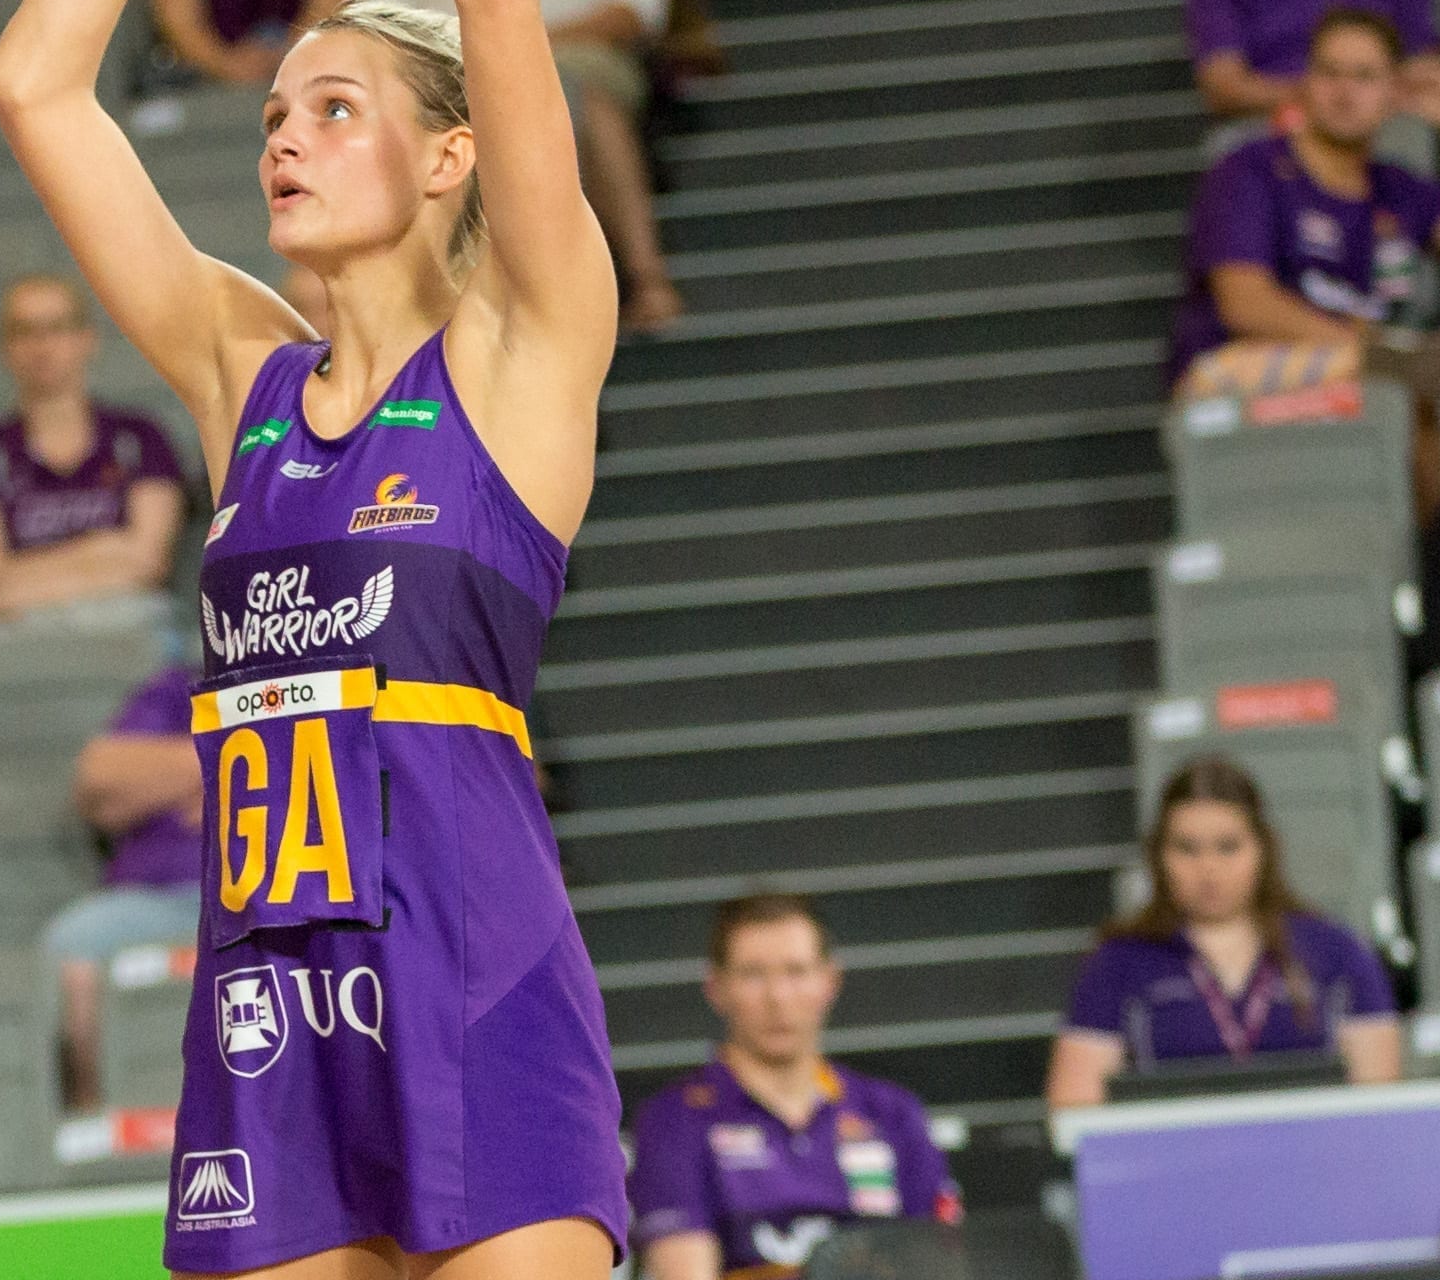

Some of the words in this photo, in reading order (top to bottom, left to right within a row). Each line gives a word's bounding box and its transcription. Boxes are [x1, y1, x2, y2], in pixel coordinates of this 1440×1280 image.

[350, 506, 437, 532] FIREBIRDS
[222, 596, 353, 665] WARRIOR
[219, 718, 354, 912] GA
[288, 966, 387, 1052] UQ
